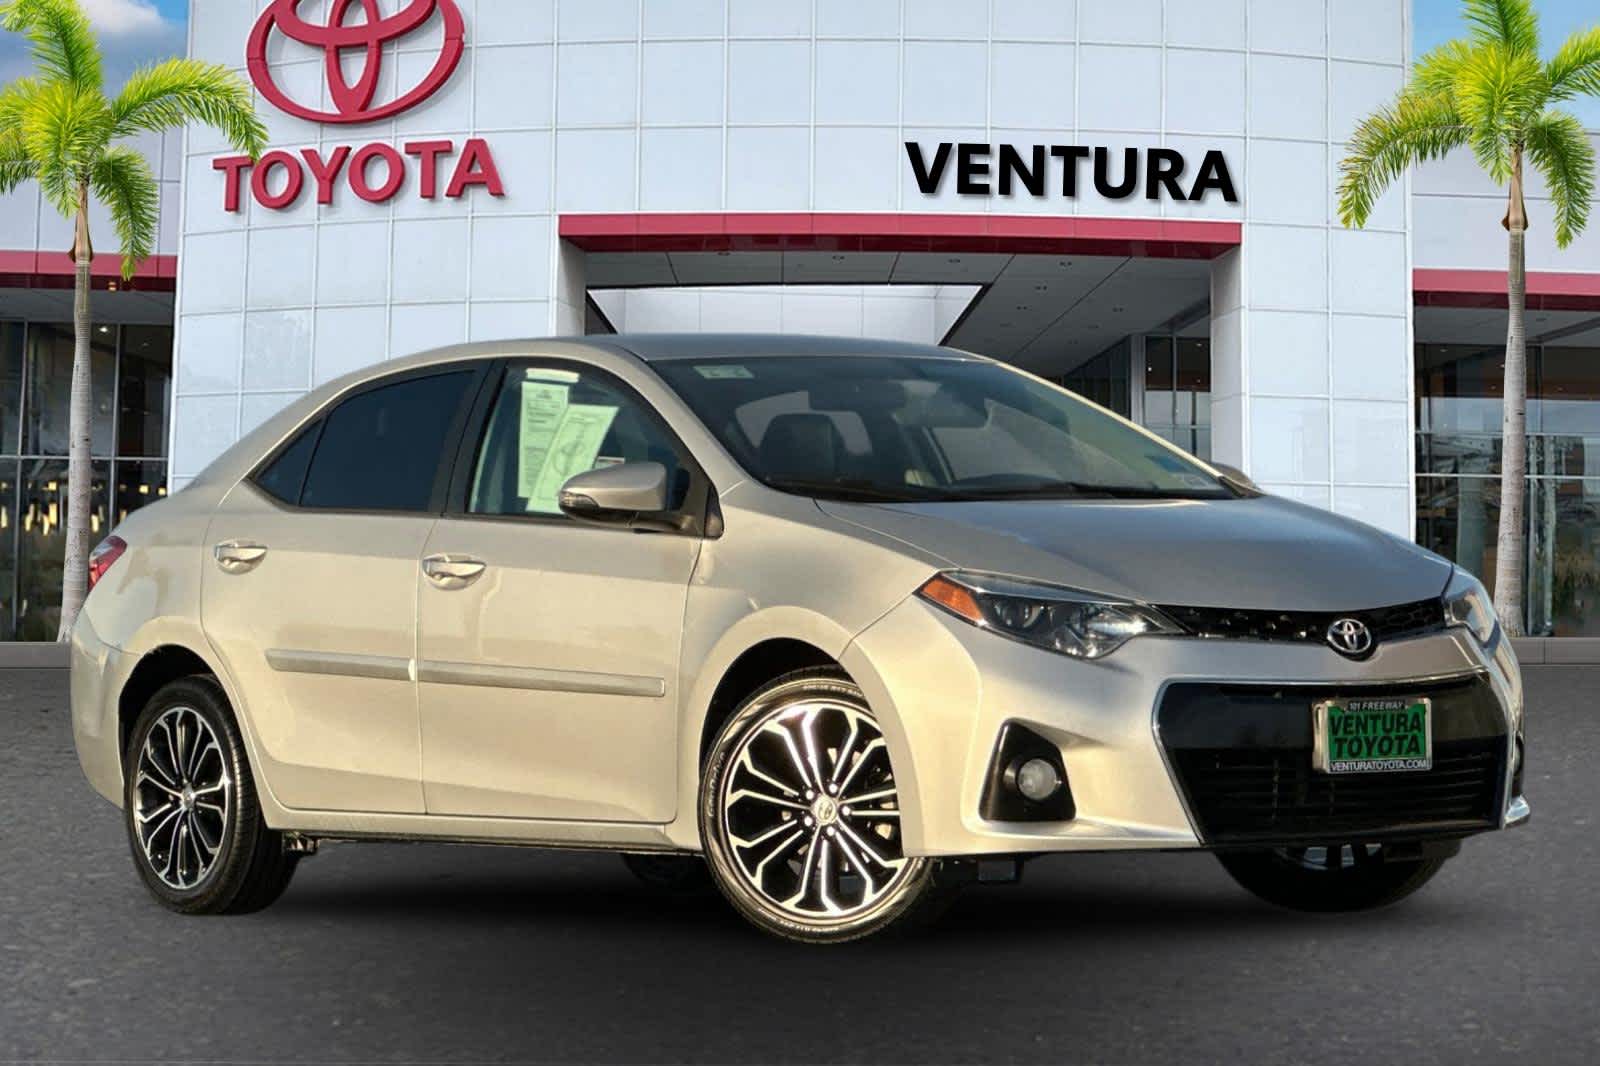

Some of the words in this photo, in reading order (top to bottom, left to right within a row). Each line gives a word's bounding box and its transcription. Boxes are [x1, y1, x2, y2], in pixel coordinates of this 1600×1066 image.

[212, 138, 505, 212] TOYOTA
[904, 141, 1238, 202] VENTURA
[1362, 701, 1402, 710] FREEWAY
[1329, 712, 1420, 735] VENTURA
[1334, 734, 1420, 758] TOYOTA
[1331, 760, 1427, 771] VENTURATOYOTA.COM
